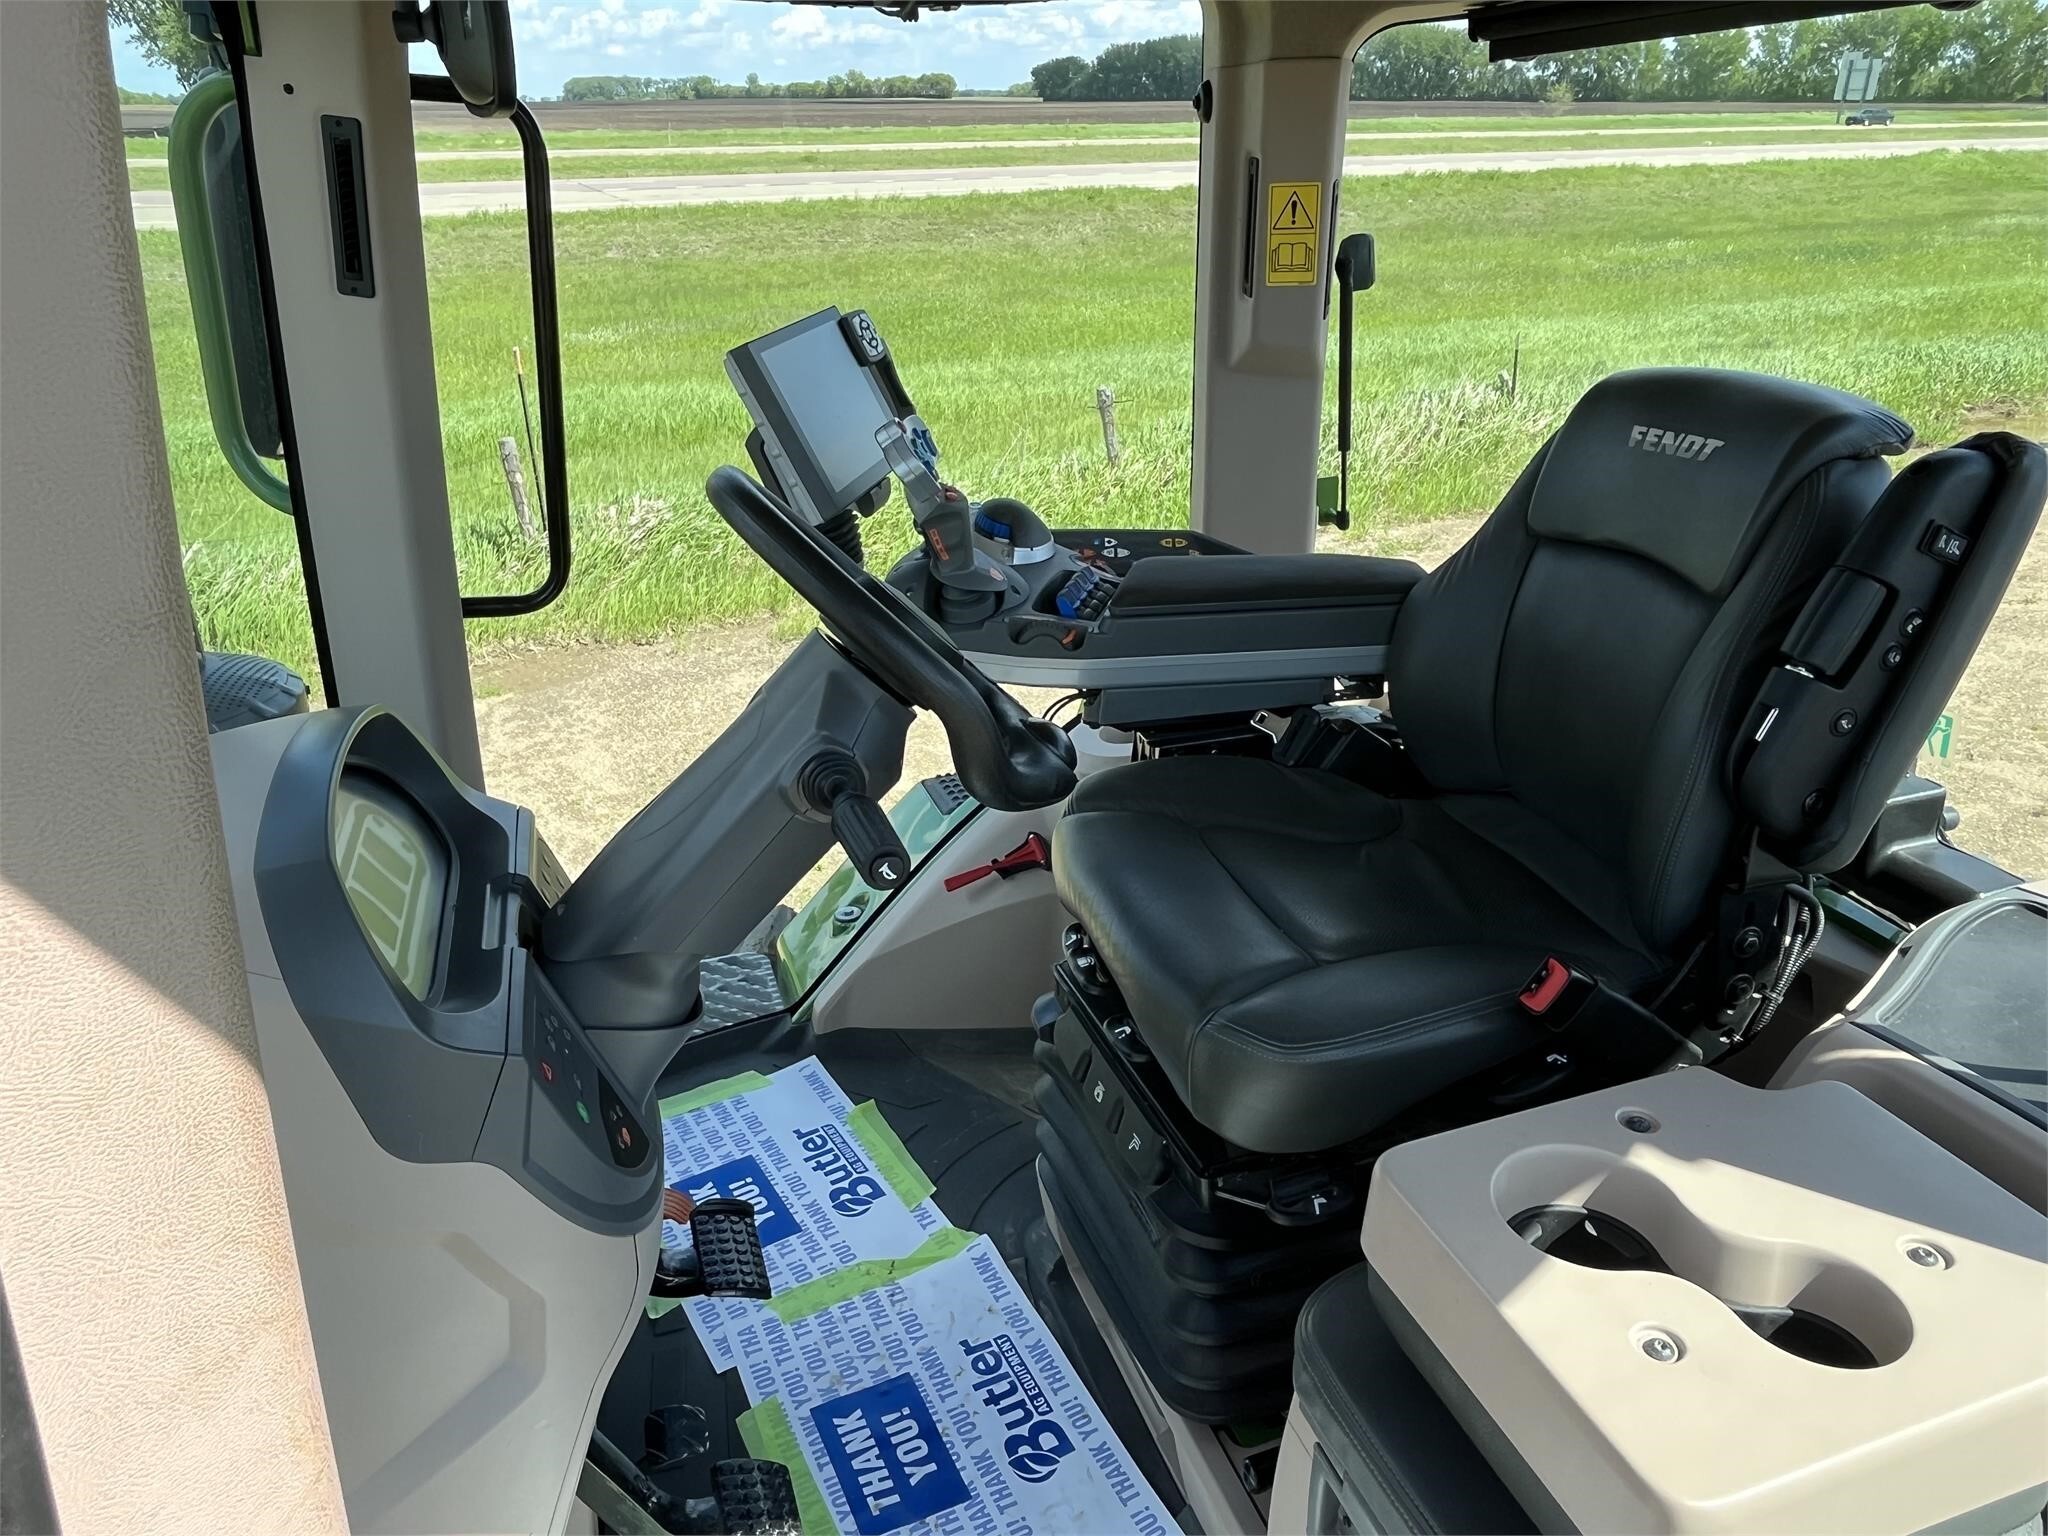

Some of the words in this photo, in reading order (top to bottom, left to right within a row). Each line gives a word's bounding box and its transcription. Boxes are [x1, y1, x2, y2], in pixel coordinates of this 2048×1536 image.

[1628, 424, 1725, 461] FENDT
[802, 1070, 837, 1103] THANK
[669, 1111, 696, 1143] THAN
[700, 1125, 726, 1151] YOU!
[727, 1128, 753, 1155] YOU!
[740, 1111, 767, 1137] YOU!
[823, 1125, 857, 1161] EQUIPMENT
[686, 1142, 713, 1170] YOU!
[757, 1135, 791, 1171] THANK
[792, 1127, 886, 1219] Butler
[851, 1161, 866, 1172] AG
[781, 1170, 811, 1200] YOU!
[801, 1198, 839, 1240] THANK
[829, 1239, 857, 1267] OU!
[970, 1251, 1010, 1301] THANK
[895, 1307, 928, 1345] YOU!
[1000, 1302, 1034, 1338] YOU!
[799, 1341, 830, 1381] YOU!
[847, 1324, 880, 1364] YOU!
[879, 1331, 913, 1372] YOU!
[749, 1359, 779, 1400] YOU!
[831, 1349, 864, 1390] YOU!
[916, 1345, 957, 1403] THANK
[996, 1336, 1040, 1395] EQUIPMENT
[1024, 1338, 1069, 1395] THANK
[780, 1367, 812, 1410] YOU!
[1032, 1397, 1050, 1413] AG
[945, 1403, 983, 1448] YOU!
[958, 1339, 1076, 1486] Butler
[1059, 1396, 1099, 1441] YOU!
[797, 1413, 831, 1472] THANK
[832, 1408, 901, 1515] THANK
[879, 1406, 938, 1486] YOU!
[969, 1448, 1019, 1515] THANK
[1087, 1440, 1142, 1506] THANK
